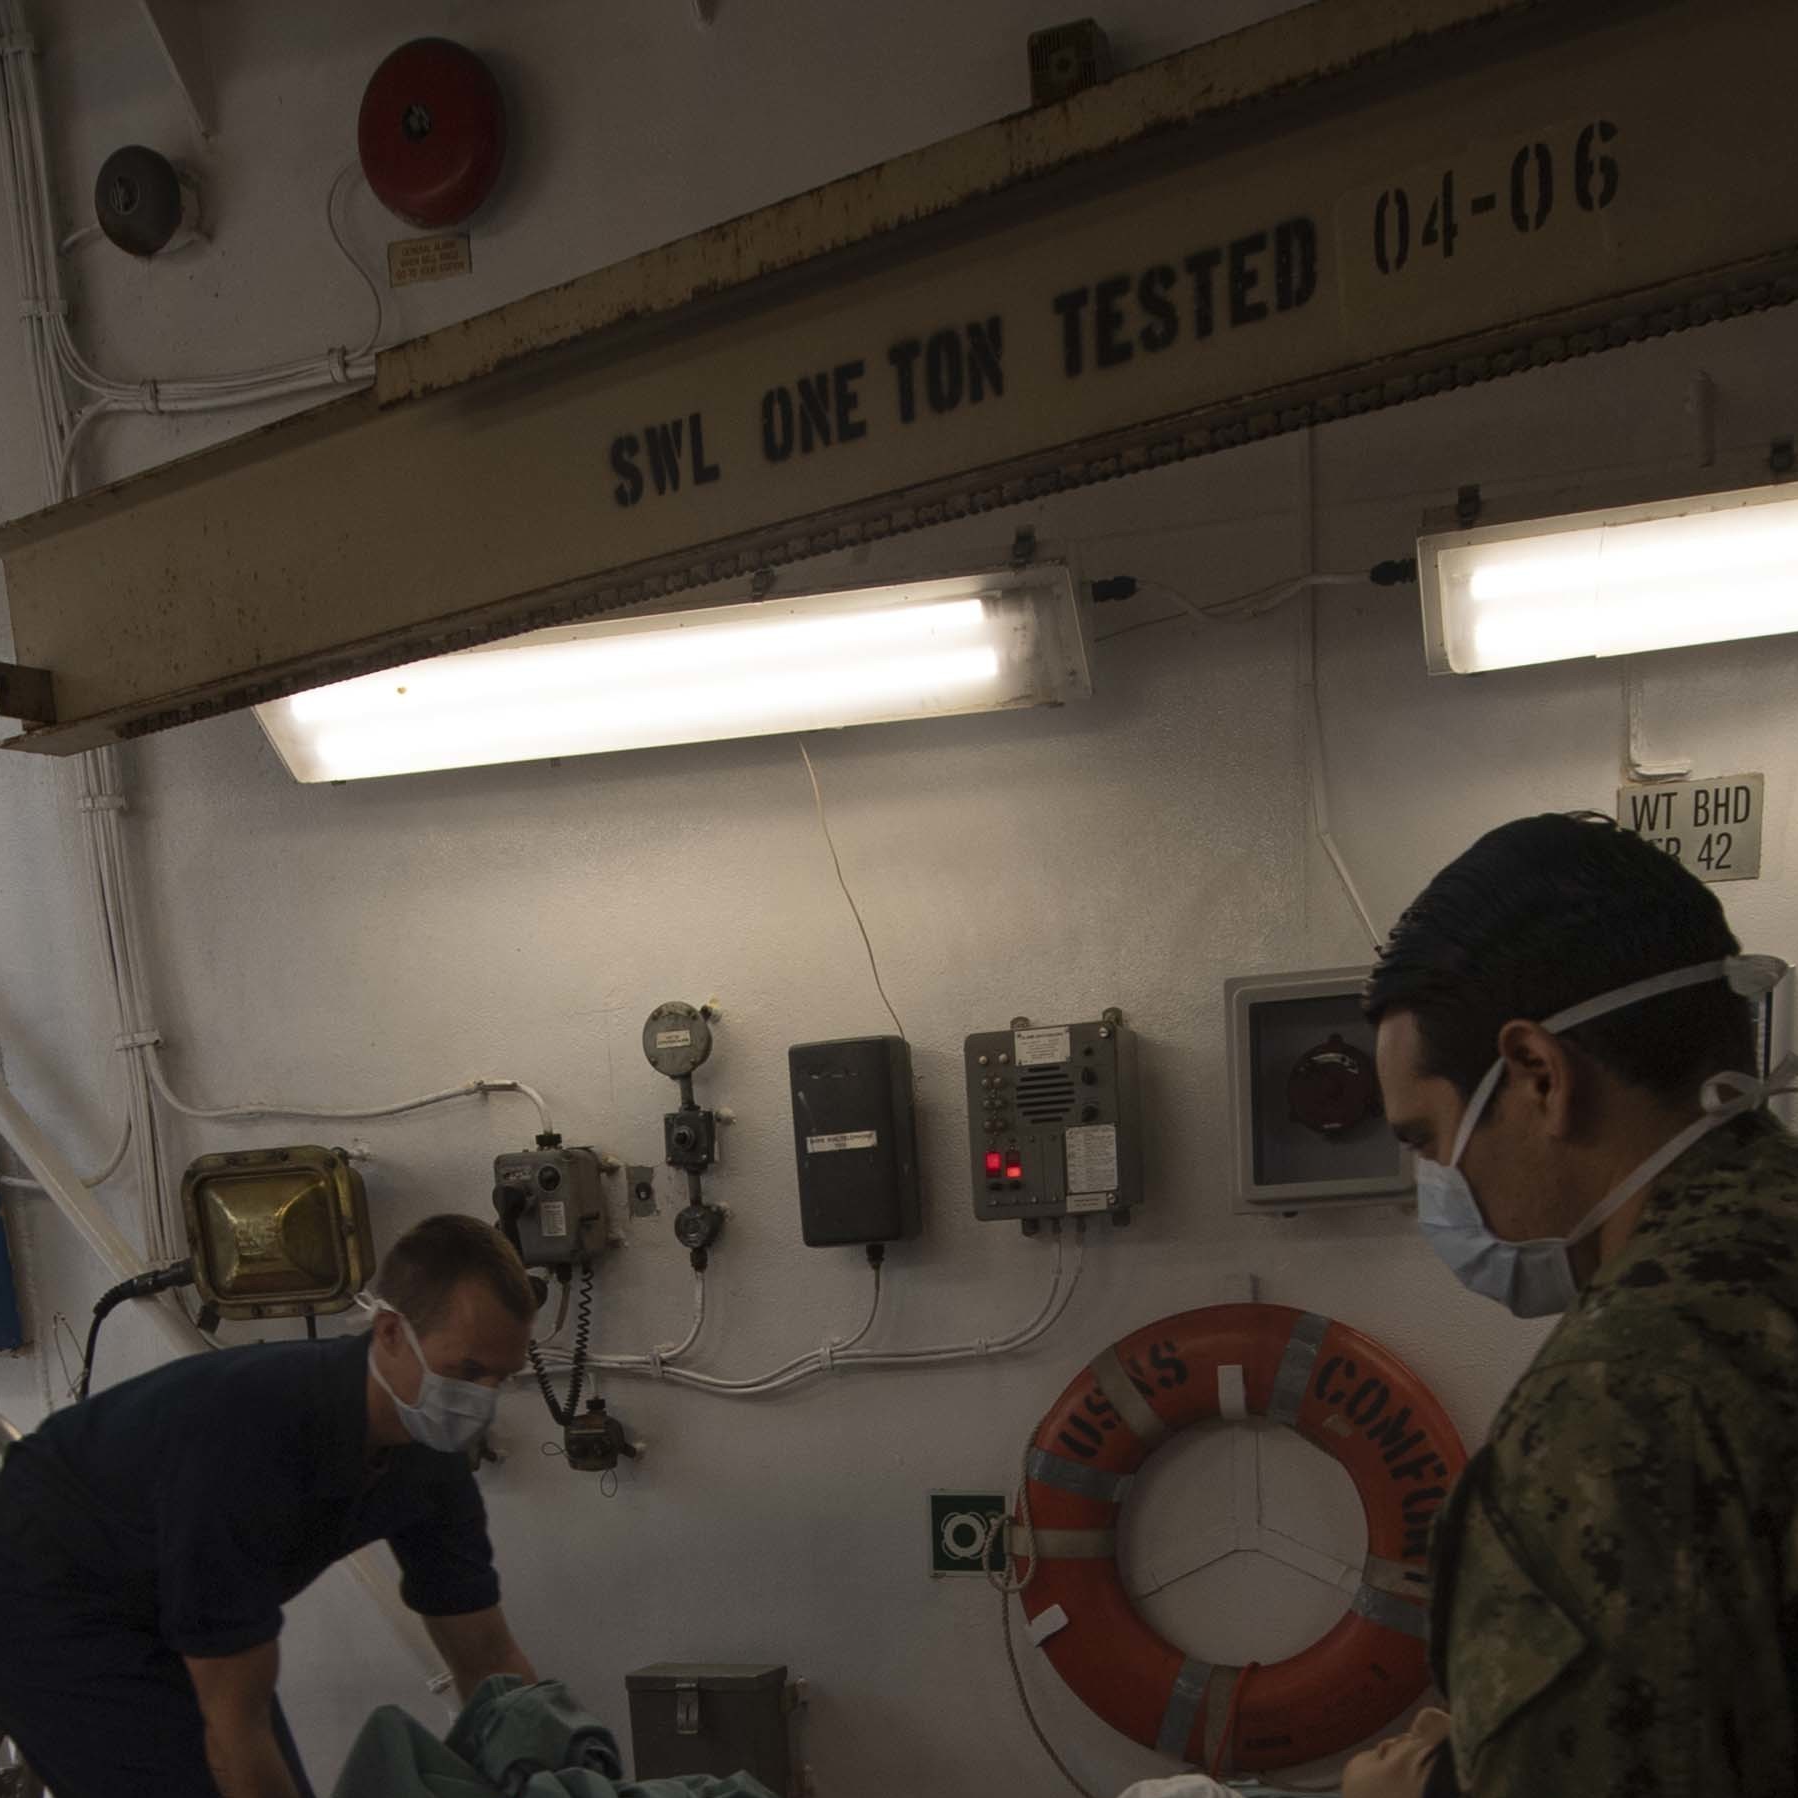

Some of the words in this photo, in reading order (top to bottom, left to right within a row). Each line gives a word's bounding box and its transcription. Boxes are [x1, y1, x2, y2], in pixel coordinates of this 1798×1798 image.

[610, 412, 720, 507] SWL
[763, 359, 868, 463] ONE
[887, 315, 1005, 424] TON
[1052, 214, 1318, 379] TESTED
[1373, 120, 1619, 276] 04-06
[1631, 791, 1679, 832] WT
[1693, 785, 1752, 828] BHD
[1697, 832, 1734, 871] 42
